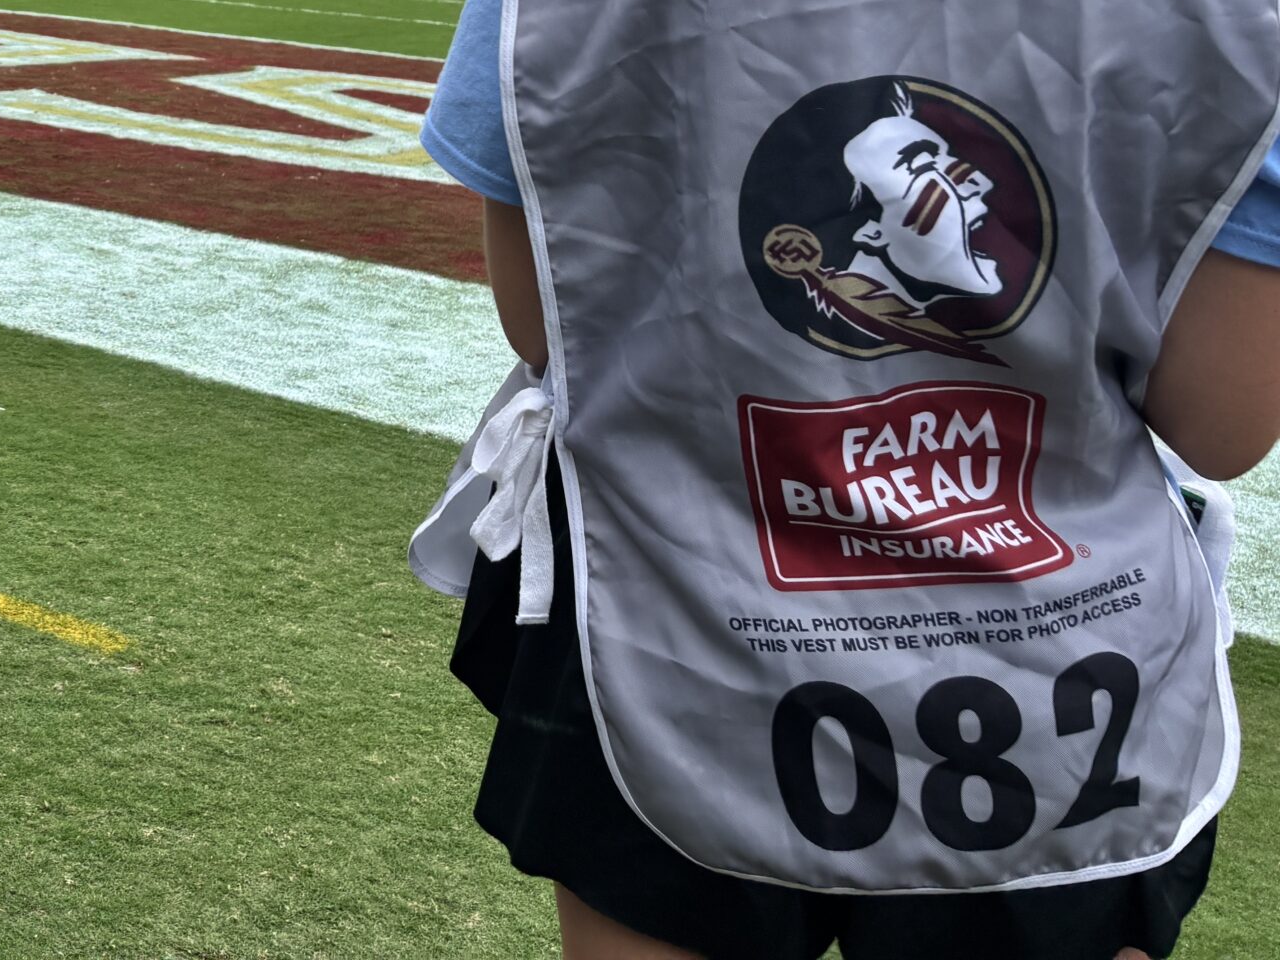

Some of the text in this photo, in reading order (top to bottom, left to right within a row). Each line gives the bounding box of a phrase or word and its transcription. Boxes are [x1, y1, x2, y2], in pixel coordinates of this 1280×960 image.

[841, 408, 1001, 473] FARM
[780, 455, 1001, 525] BUREAU
[839, 519, 1033, 559] INSURANCE
[729, 616, 809, 632] OFFICIAL
[812, 611, 960, 632] PHOTOGRAPHER
[977, 608, 1018, 624] NON
[1021, 568, 1146, 620] TRANSFERRABLE
[746, 592, 1142, 653] THIS VEST MUST BE WORN FOR PHOTO ACCESS
[771, 650, 1140, 852] 082
